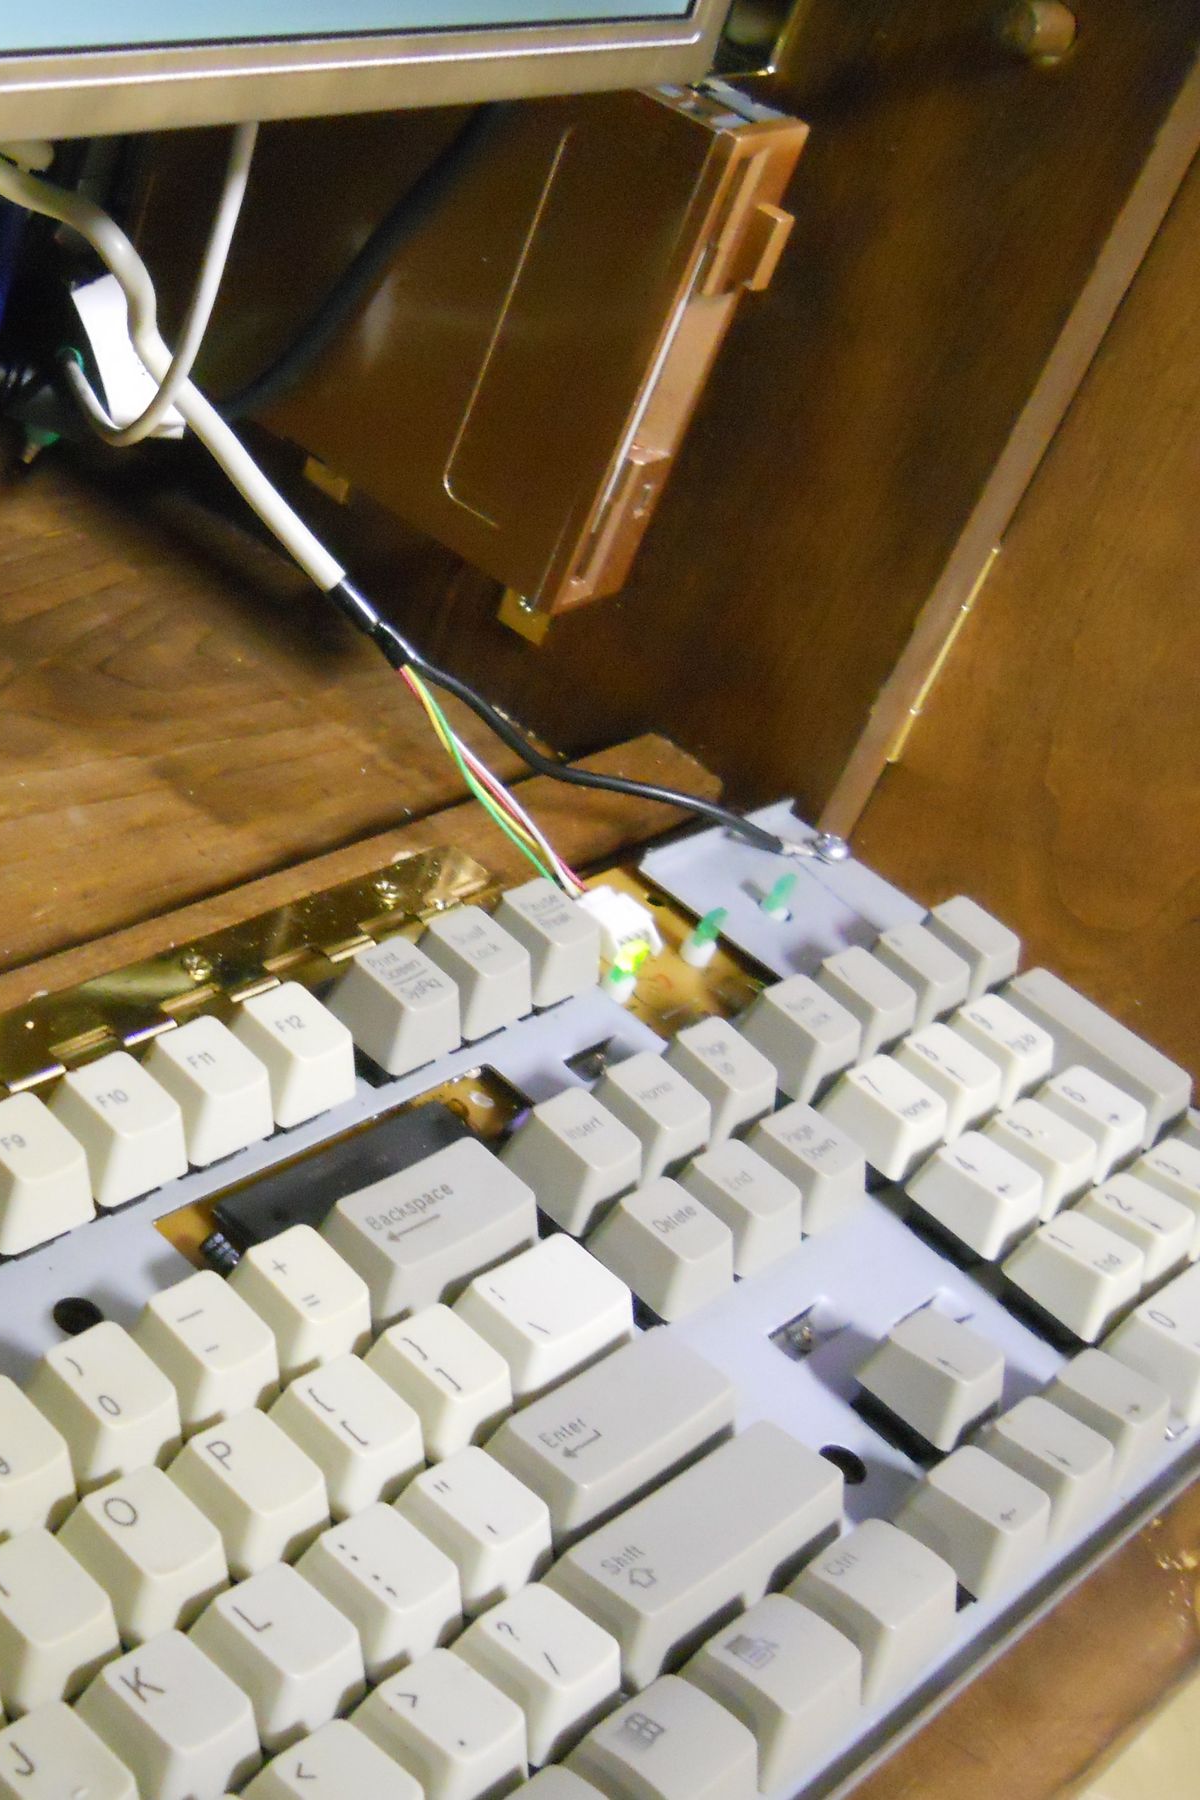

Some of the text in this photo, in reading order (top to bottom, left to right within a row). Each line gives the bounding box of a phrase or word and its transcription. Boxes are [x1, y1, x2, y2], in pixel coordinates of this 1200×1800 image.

[274, 1013, 305, 1034] F12
[186, 1050, 217, 1071] F11
[98, 1088, 130, 1110] F10
[0, 1134, 27, 1152] F9
[364, 1181, 456, 1232] Backspace
[1105, 1193, 1134, 1212] 2
[652, 1205, 698, 1235] Delete
[537, 1416, 588, 1450] Enter
[205, 1438, 236, 1472] P
[103, 1495, 140, 1527] O
[600, 1543, 647, 1576] Shift
[231, 1604, 274, 1634] L
[118, 1665, 167, 1703] K
[7, 1740, 37, 1778] J
